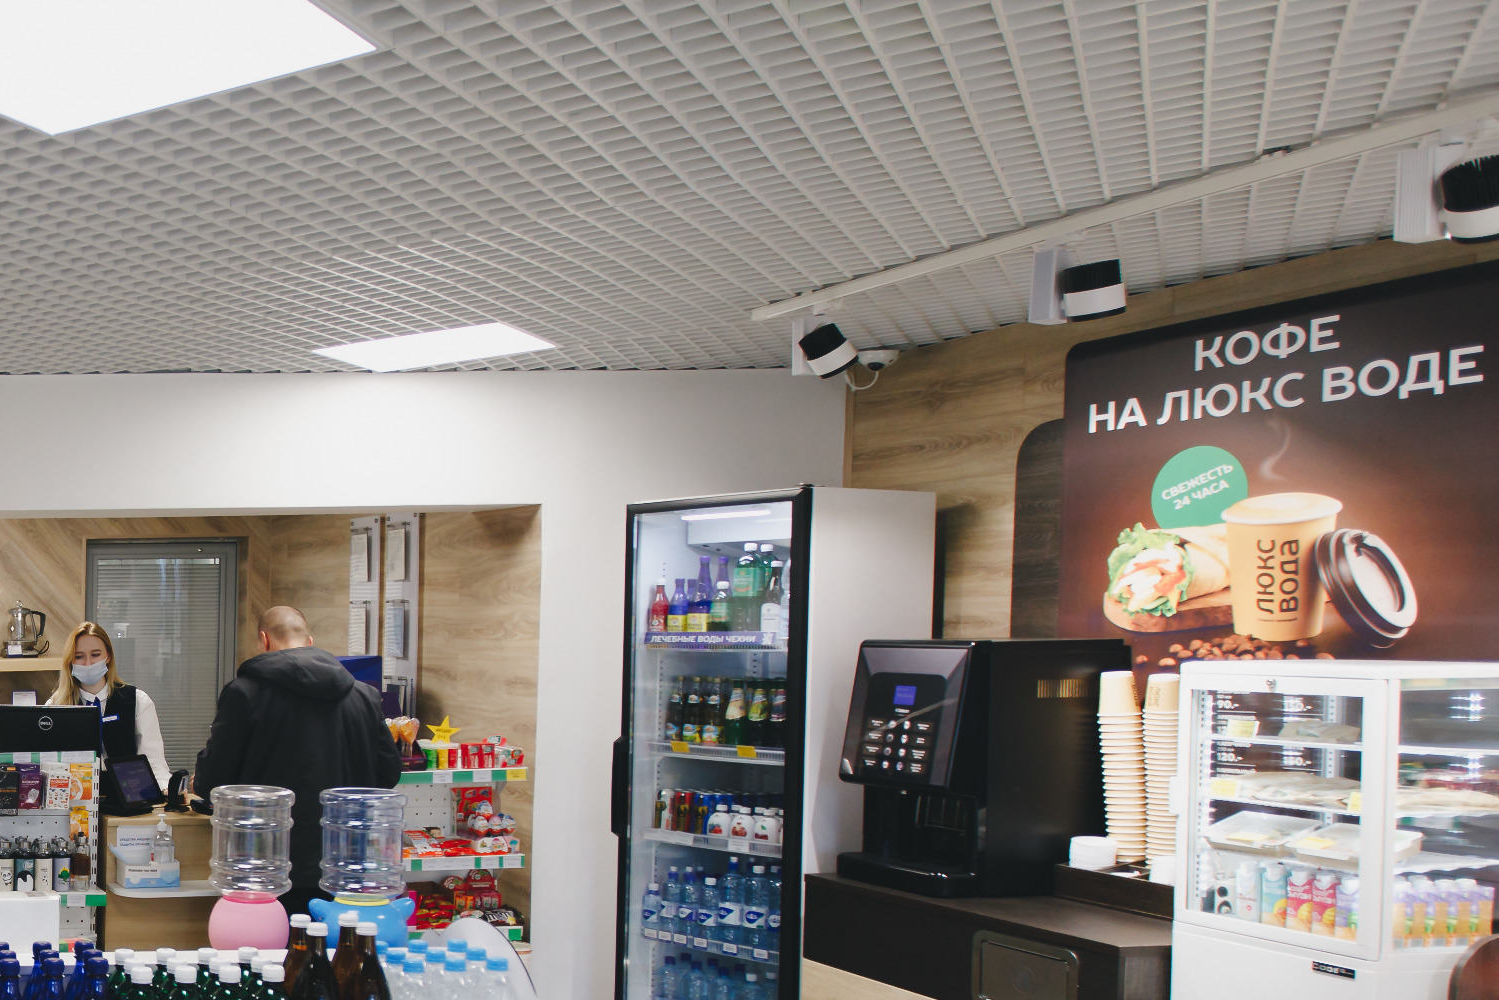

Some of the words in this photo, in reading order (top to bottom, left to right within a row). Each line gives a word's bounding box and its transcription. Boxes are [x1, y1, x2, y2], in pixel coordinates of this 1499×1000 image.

[1194, 313, 1341, 372] КОФЕ
[1087, 397, 1148, 434] НА
[1156, 371, 1305, 426] ЛЮКС
[1321, 344, 1485, 403] ВОДЕ
[1161, 462, 1235, 502] СВЕЖЕСТЬ
[1172, 492, 1191, 511] 24
[1190, 479, 1230, 502] ЧАСА
[650, 635, 696, 643] ЛЕЧЕБНЫЕ
[697, 635, 724, 644] ВОДЫ
[725, 635, 757, 643] ЧЕХИИ
